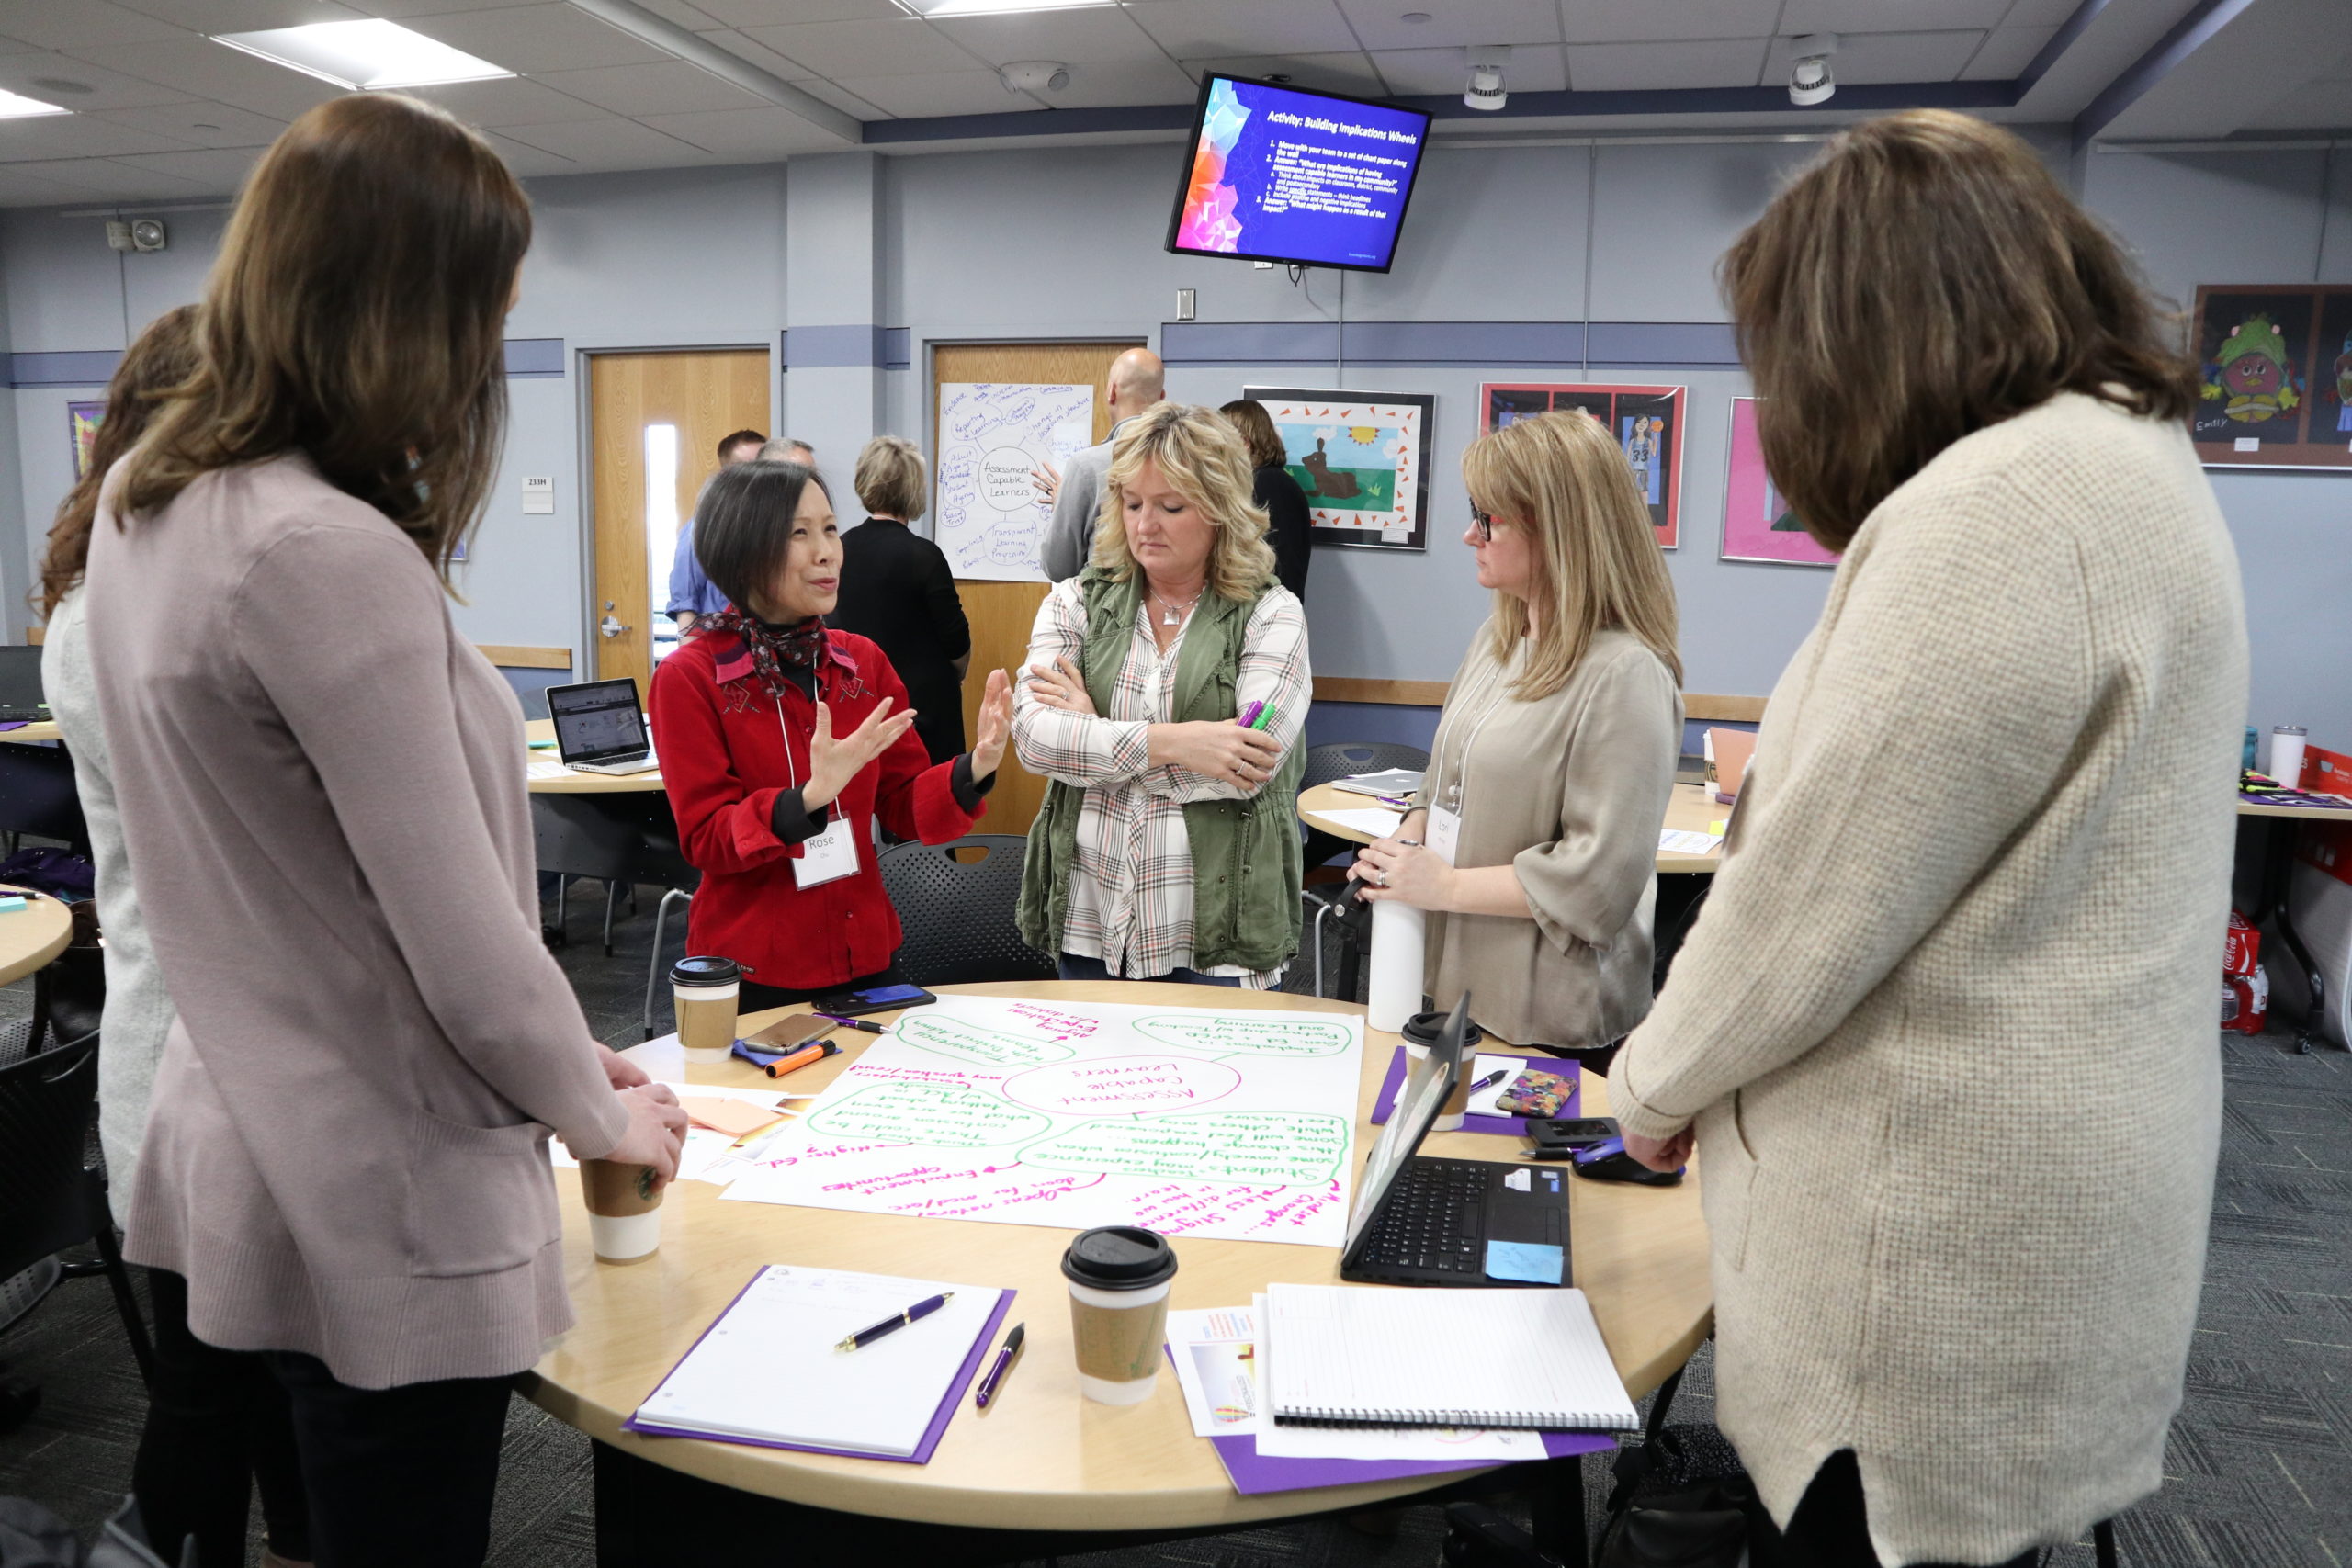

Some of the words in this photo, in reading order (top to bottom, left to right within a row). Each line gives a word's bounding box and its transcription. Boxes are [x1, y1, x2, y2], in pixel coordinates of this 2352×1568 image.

[1268, 110, 1303, 128] Activity:
[1305, 117, 1339, 134] Building
[1340, 122, 1386, 140] Implications
[1389, 130, 1417, 145] Wheels
[1278, 141, 1295, 150] Move
[1295, 143, 1308, 152] with
[1322, 148, 1337, 156] team
[1363, 153, 1377, 163] chart
[1376, 157, 1393, 165] paper
[1393, 158, 1408, 168] along
[1287, 150, 1300, 158] wall
[1274, 155, 1298, 165] Answer:
[1299, 159, 1317, 168] "What
[1326, 163, 1358, 175] implications
[1365, 168, 1383, 179] having
[1272, 164, 1305, 175] assessment
[1305, 168, 1327, 177] capable
[1326, 171, 1349, 180] learners
[1354, 175, 1363, 185] my
[2195, 419, 2228, 431] Emily
[984, 461, 1030, 474] Assessment
[987, 473, 1025, 487] Capable
[990, 487, 1030, 497] Learners
[808, 836, 835, 850] Rose
[911, 1019, 950, 1036] Admin
[1213, 1018, 1287, 1030] Learning
[1185, 1032, 1233, 1041] SPED
[911, 1030, 1007, 1063] Transparency
[954, 1033, 1003, 1054] District
[990, 1034, 1039, 1053] teams
[1011, 1050, 1045, 1061] with
[1070, 1064, 1179, 1078] Learners
[1086, 1076, 1183, 1091] Capable
[876, 1095, 927, 1104] about
[1056, 1088, 1194, 1105] Assessment
[940, 1098, 1001, 1110] talking
[833, 1111, 901, 1121] around
[1298, 1118, 1338, 1126] feel
[825, 1120, 850, 1129] be
[914, 1117, 1007, 1128] confusion
[1159, 1118, 1198, 1127] may
[1208, 1122, 1272, 1132] others
[922, 1129, 987, 1140] There
[1088, 1123, 1199, 1136] empowered
[1285, 1125, 1334, 1135] while
[1207, 1133, 1244, 1142] feel
[806, 1145, 871, 1158] Higher
[1055, 1143, 1103, 1153] when
[1222, 1140, 1290, 1153] change
[1296, 1145, 1336, 1155] this
[1033, 1153, 1144, 1165] experience
[1153, 1158, 1194, 1169] may
[1122, 1167, 1199, 1178] Teachers
[1208, 1165, 1320, 1181] Students
[820, 1166, 942, 1192] opportunities
[860, 1169, 978, 1196] Enrichment
[992, 1187, 1019, 1196] for
[1197, 1185, 1215, 1193] in
[1226, 1186, 1252, 1194] for
[1002, 1190, 1057, 1206] Opens
[1160, 1192, 1193, 1204] how
[1132, 1205, 1158, 1216] we
[1289, 1193, 1341, 1227] Mindset
